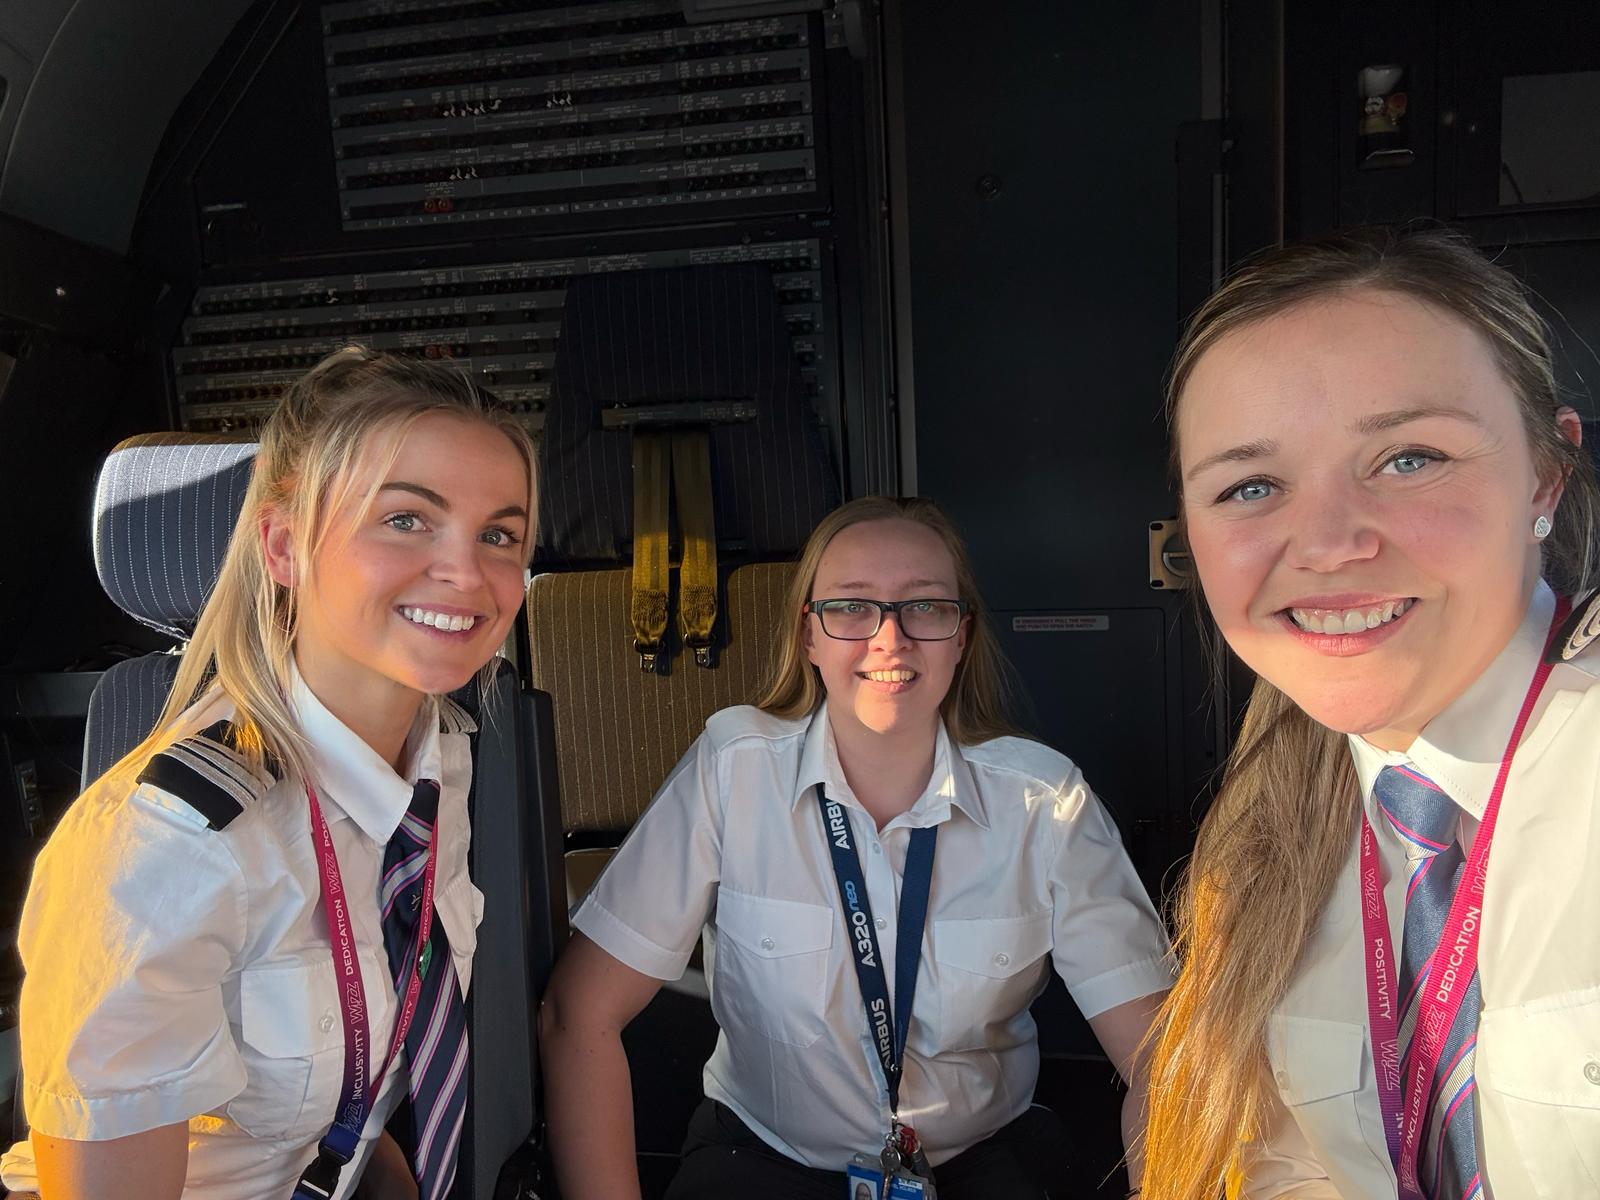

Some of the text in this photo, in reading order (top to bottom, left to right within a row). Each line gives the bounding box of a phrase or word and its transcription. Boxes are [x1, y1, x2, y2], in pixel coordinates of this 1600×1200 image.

[846, 880, 876, 968] A320 neo
[871, 998, 891, 1070] AIRBUS
